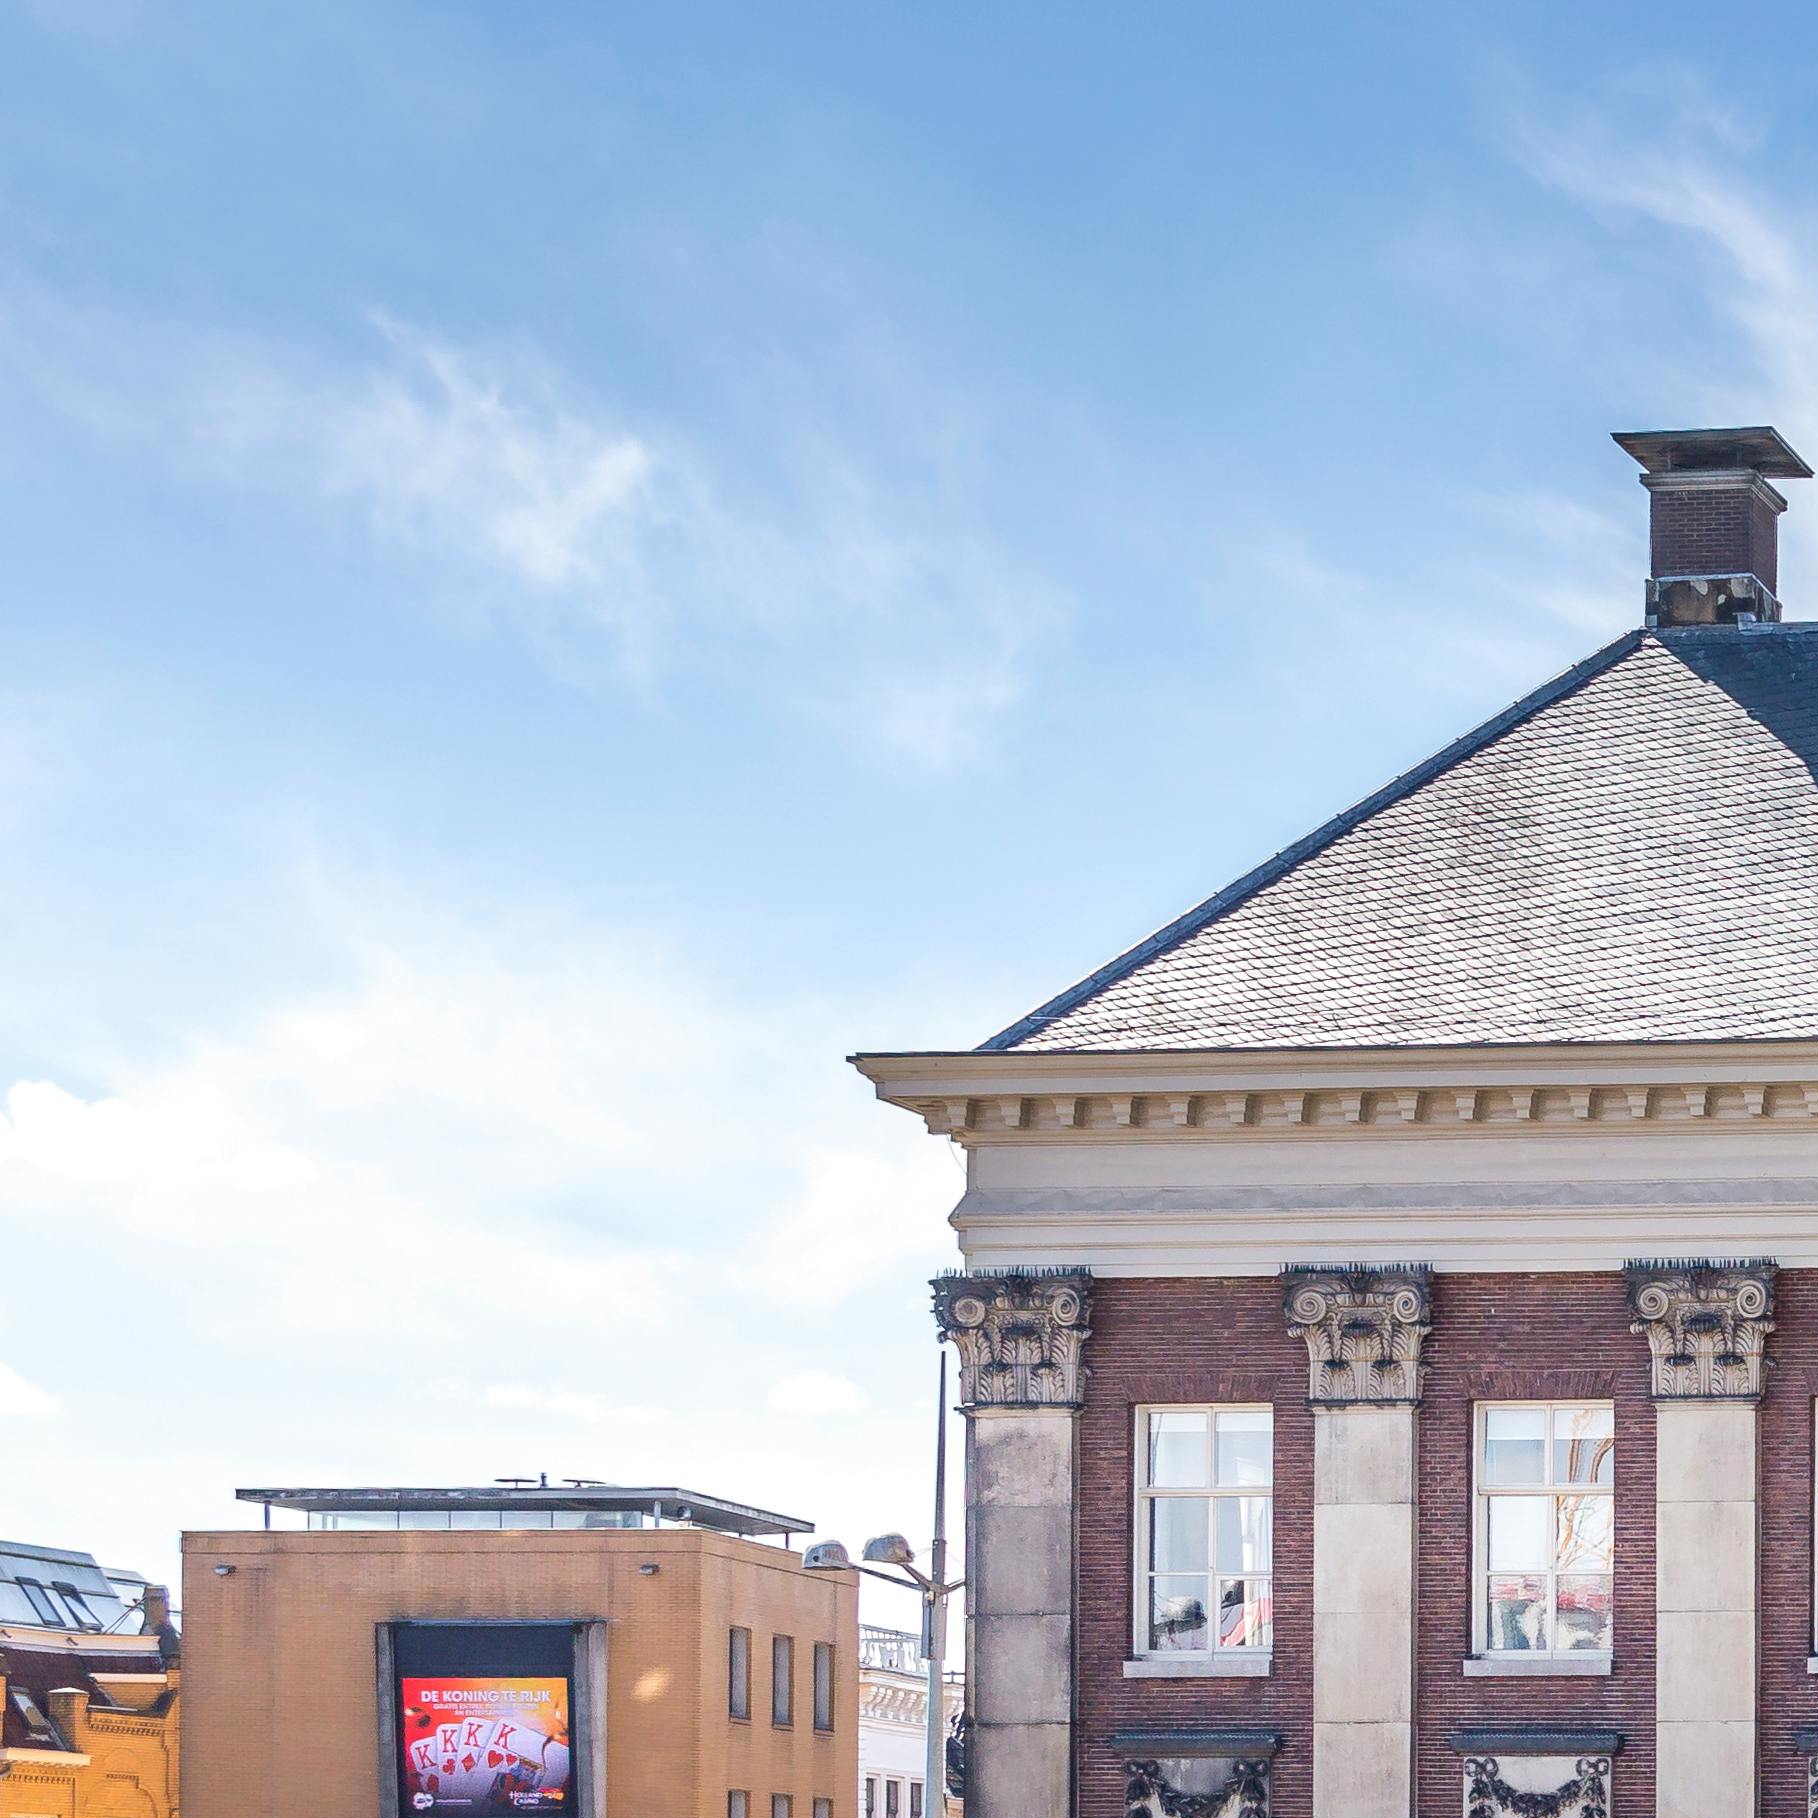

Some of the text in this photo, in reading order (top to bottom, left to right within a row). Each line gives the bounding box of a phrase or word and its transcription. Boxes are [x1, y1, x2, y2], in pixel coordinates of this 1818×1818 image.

[421, 1690, 552, 1703] DE KONING TE RIJK
[441, 1729, 458, 1753] K
[464, 1722, 485, 1748] K
[494, 1723, 517, 1750] K
[415, 1743, 438, 1770] K
